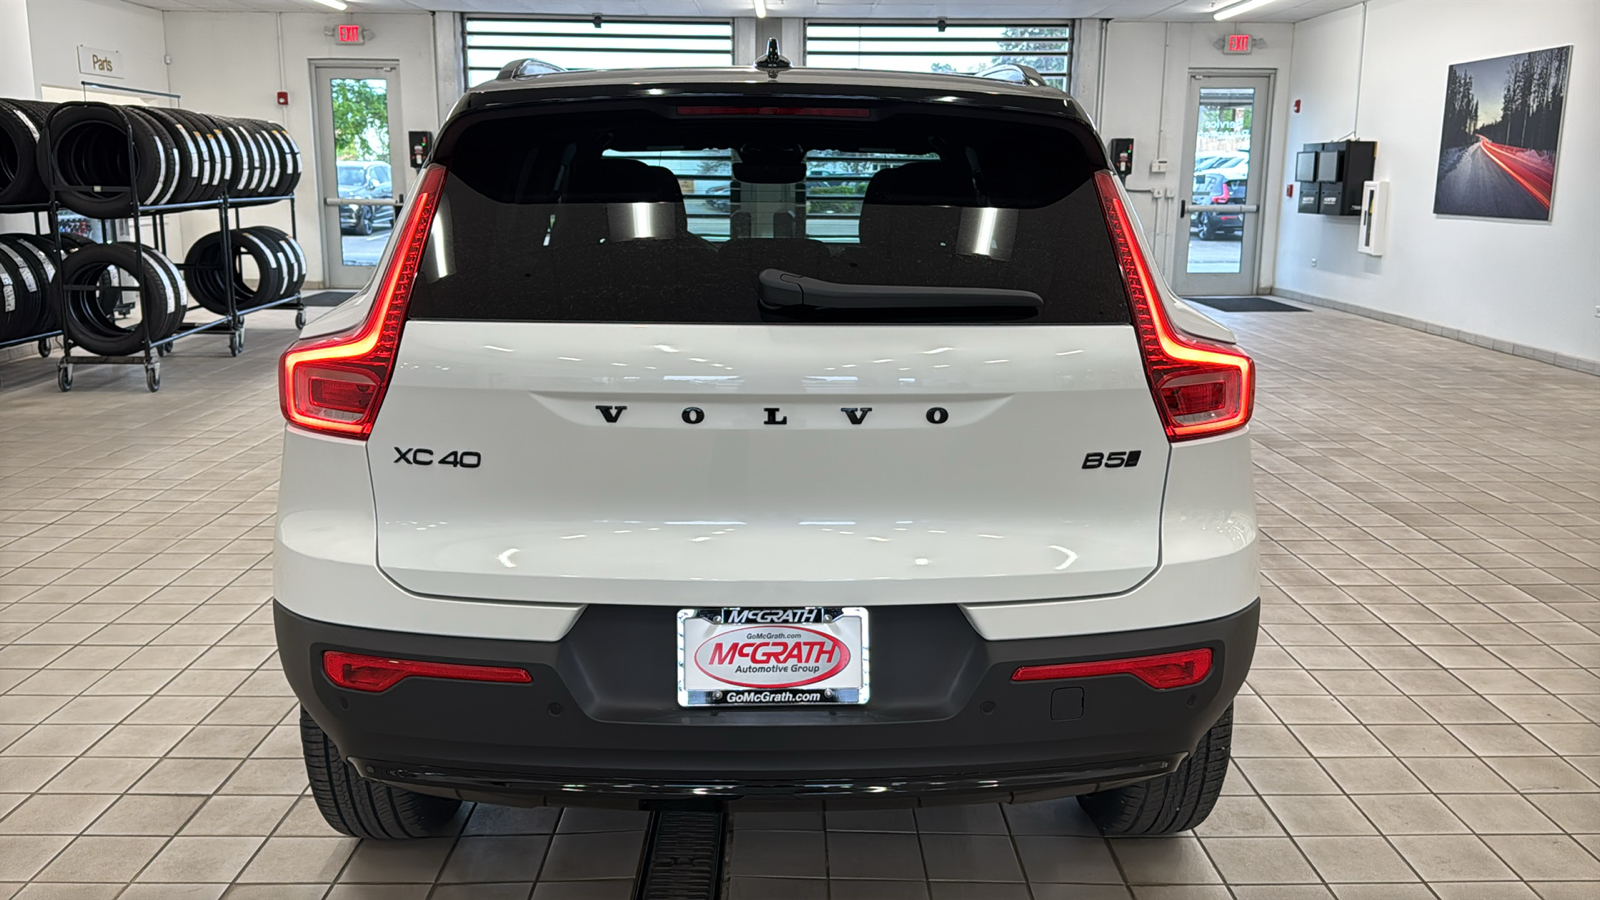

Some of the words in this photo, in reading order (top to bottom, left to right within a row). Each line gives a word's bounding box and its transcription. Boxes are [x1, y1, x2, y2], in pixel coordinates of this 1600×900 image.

[339, 24, 360, 42] EXIT
[1229, 34, 1250, 51] EXIT
[92, 54, 113, 72] Parts
[595, 404, 949, 425] VOLVO
[1081, 451, 1127, 470] B5
[746, 632, 802, 640] GoMcGrath.com
[735, 665, 789, 674] Automotive
[792, 664, 820, 674] Group
[726, 691, 821, 703] GoMcGrath.com
